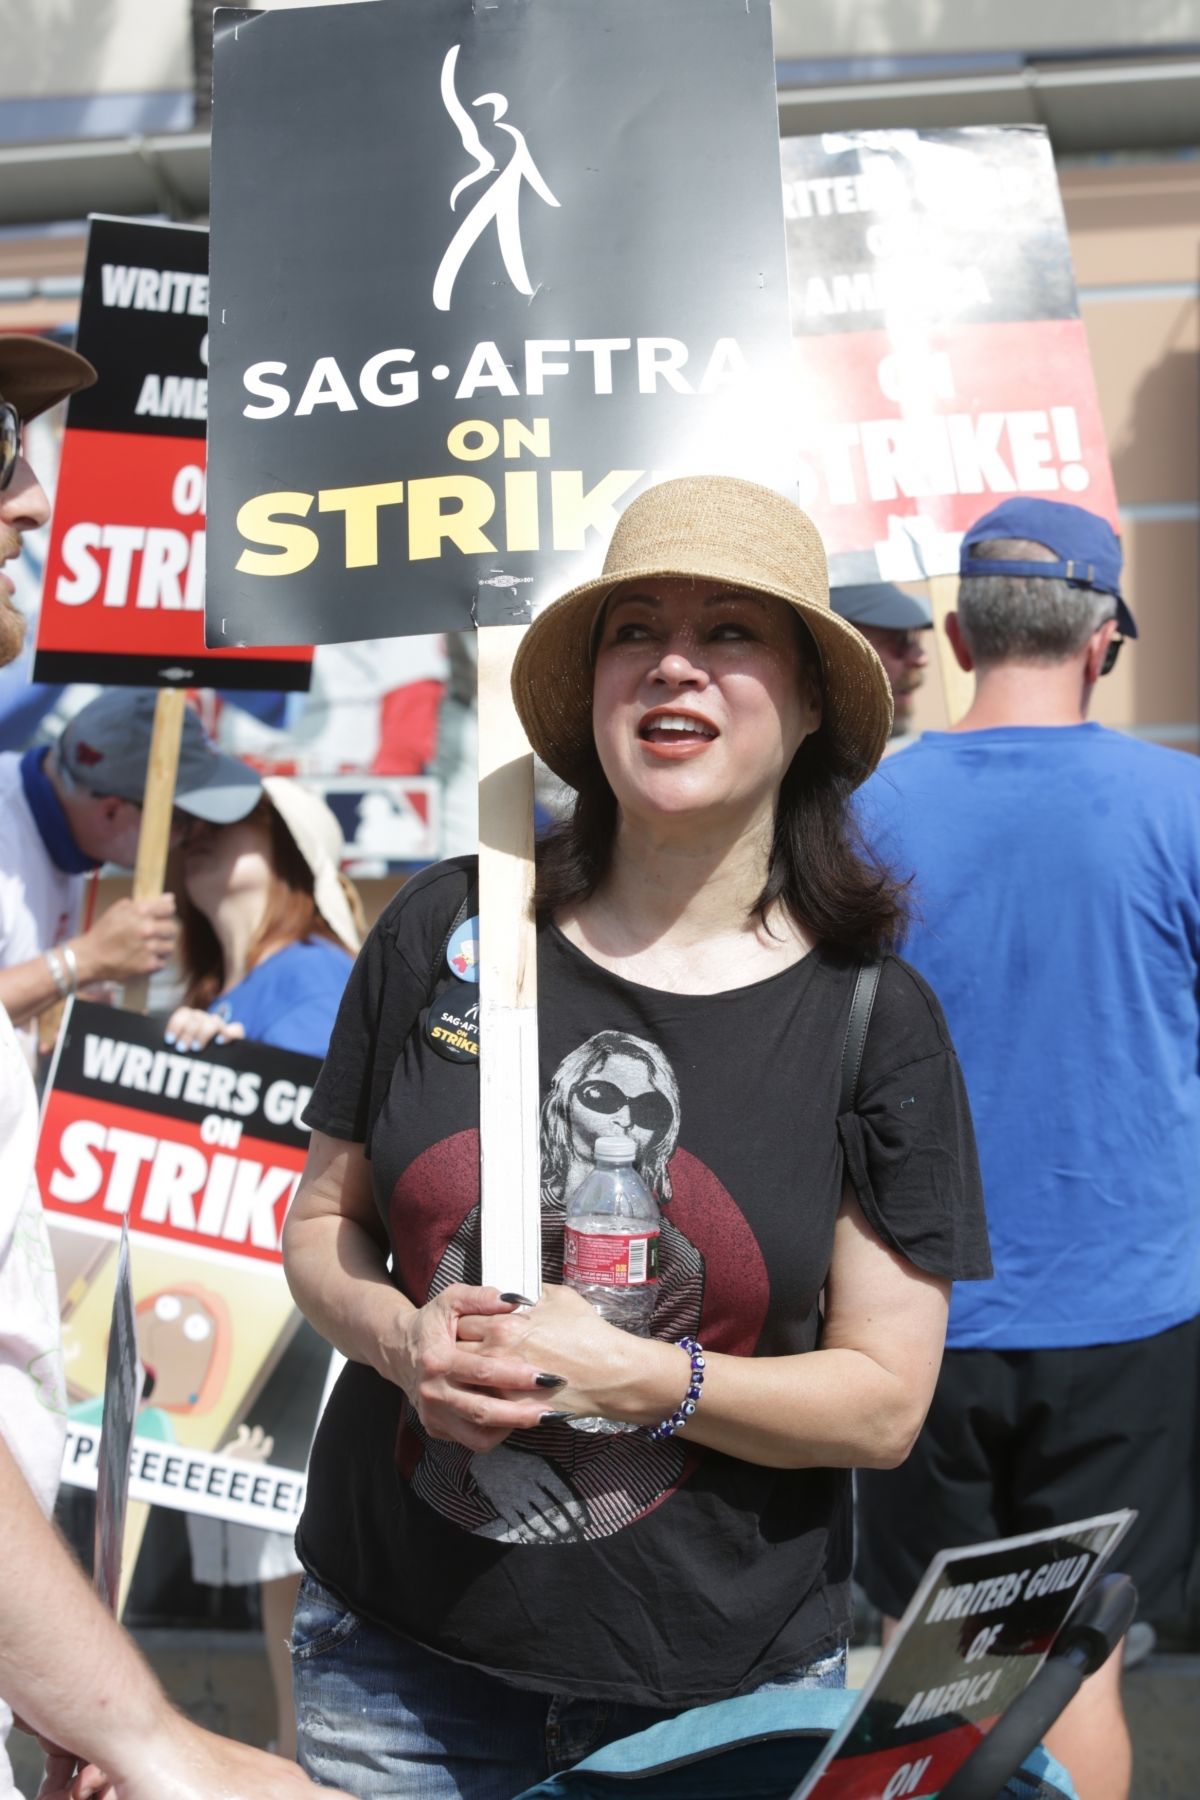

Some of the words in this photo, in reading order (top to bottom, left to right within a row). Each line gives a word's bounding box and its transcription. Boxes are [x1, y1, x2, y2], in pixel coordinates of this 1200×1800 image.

[446, 417, 551, 462] ON
[171, 464, 207, 516] O
[456, 1029, 469, 1038] ON
[82, 1033, 262, 1115] WRITERS
[200, 1113, 244, 1150] ON
[924, 1569, 1031, 1625] WRITERS
[1023, 1553, 1091, 1602] GUILD
[964, 1623, 1005, 1665] OF
[893, 1669, 1003, 1730] AMERICA
[881, 1754, 934, 1800] ON
